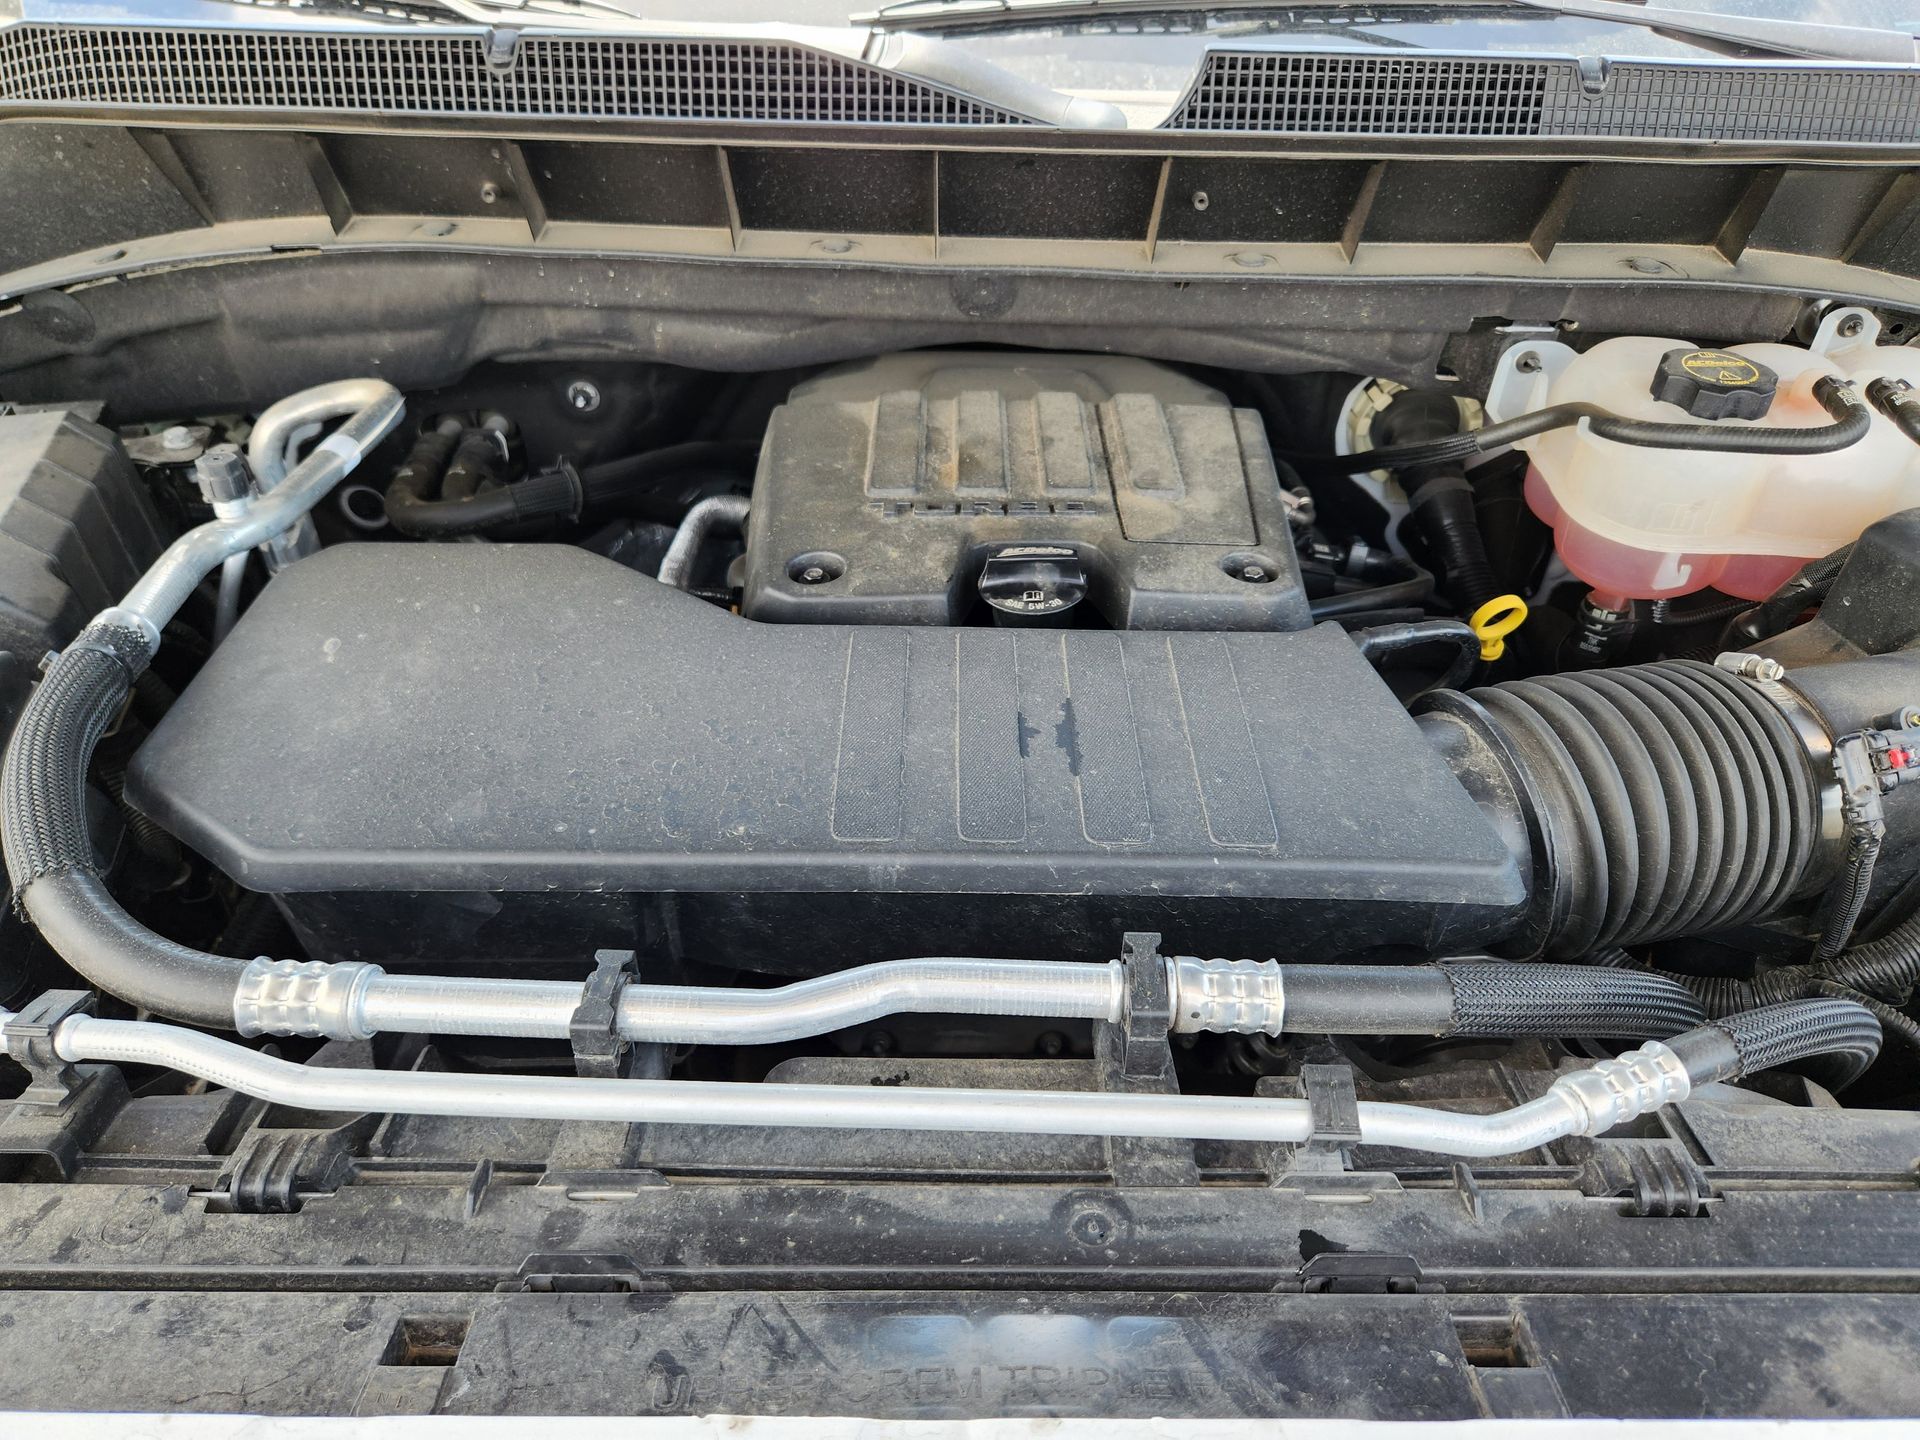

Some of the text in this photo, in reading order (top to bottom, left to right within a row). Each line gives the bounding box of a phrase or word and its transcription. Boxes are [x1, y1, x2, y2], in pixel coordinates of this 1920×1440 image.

[1004, 598, 1063, 610] SAE 5W-30
[999, 1365, 1174, 1400] TRIPLE
